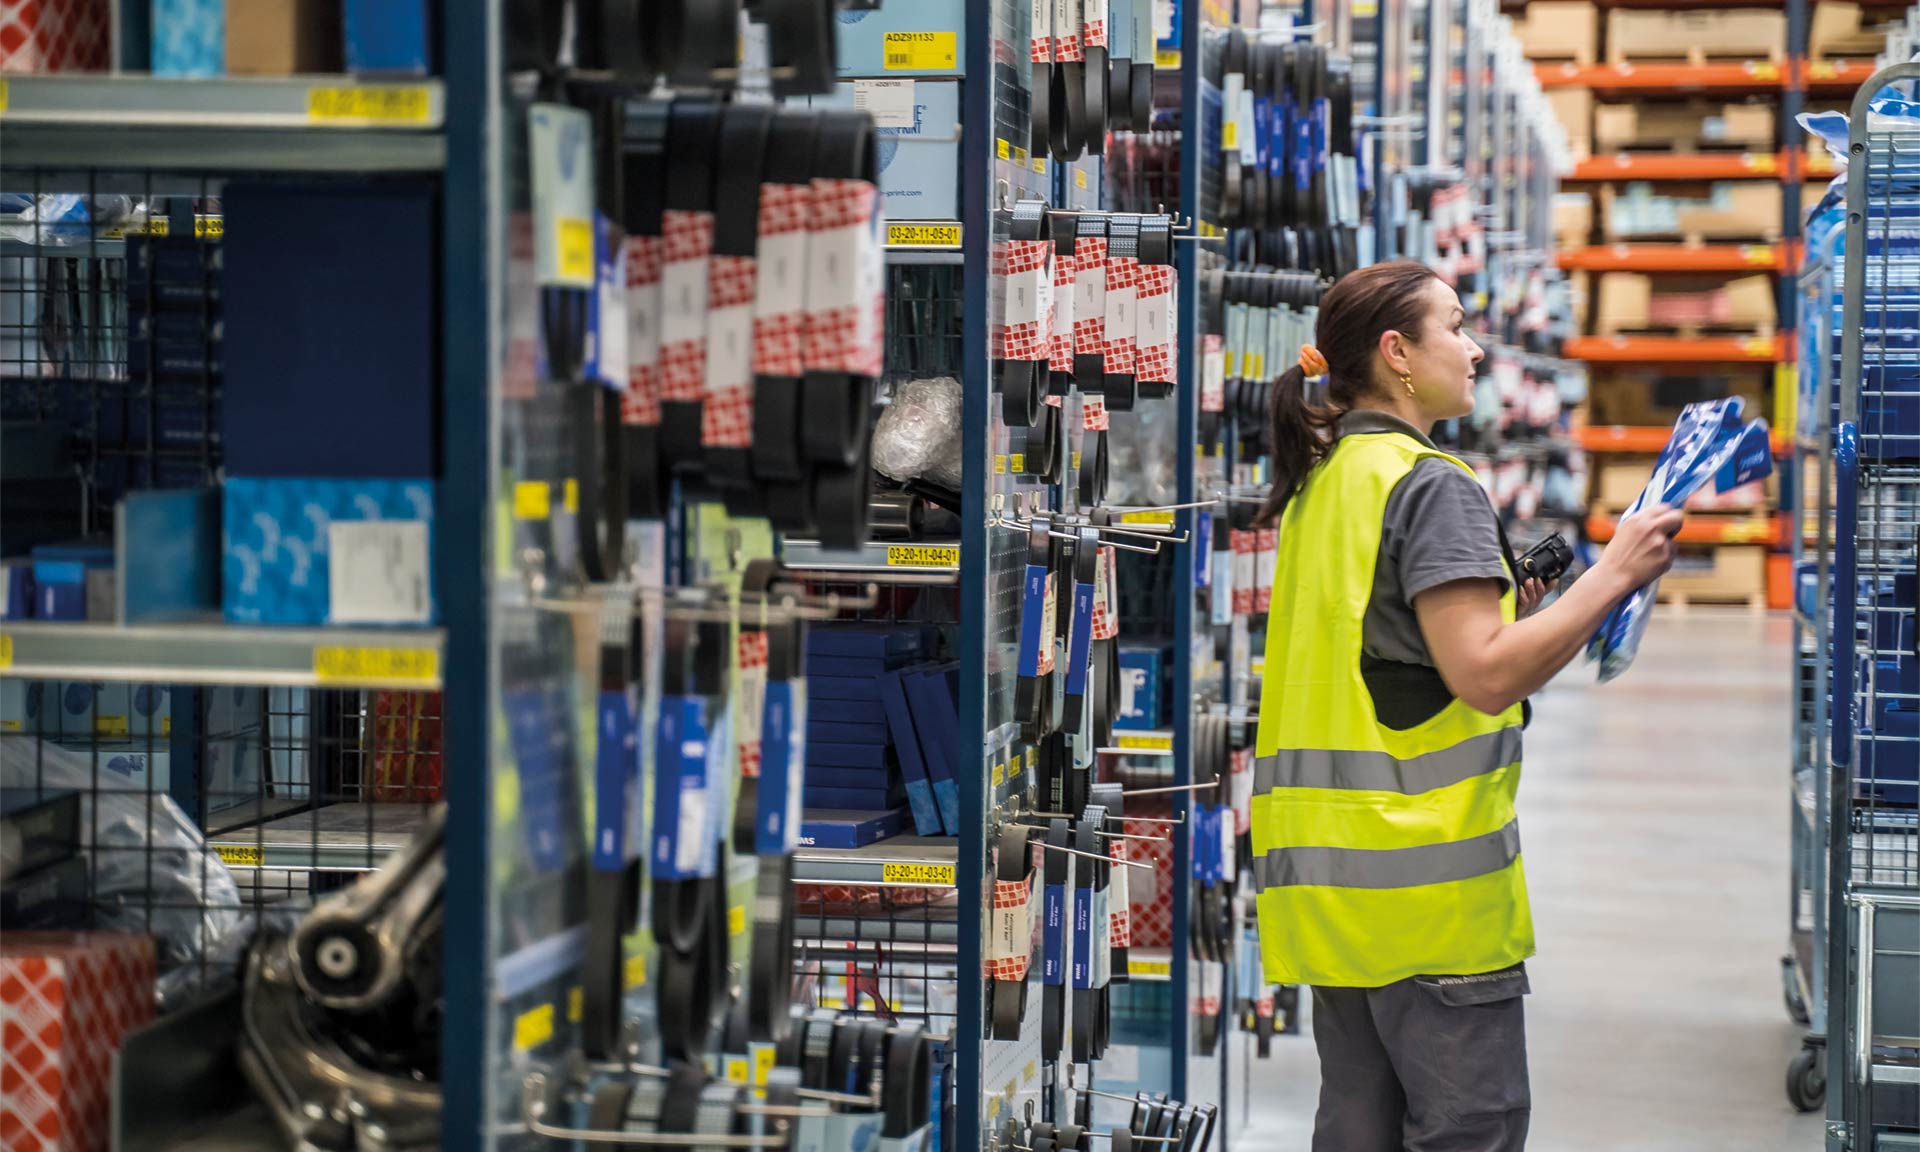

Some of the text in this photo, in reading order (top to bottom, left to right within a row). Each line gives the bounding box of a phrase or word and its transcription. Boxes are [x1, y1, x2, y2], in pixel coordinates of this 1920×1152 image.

[886, 33, 934, 42] ADZ91133
[890, 227, 958, 240] 03-20-11-05-01
[889, 547, 957, 561] 03-20-11-04-01
[885, 864, 952, 878] 03-20-11-03-01
